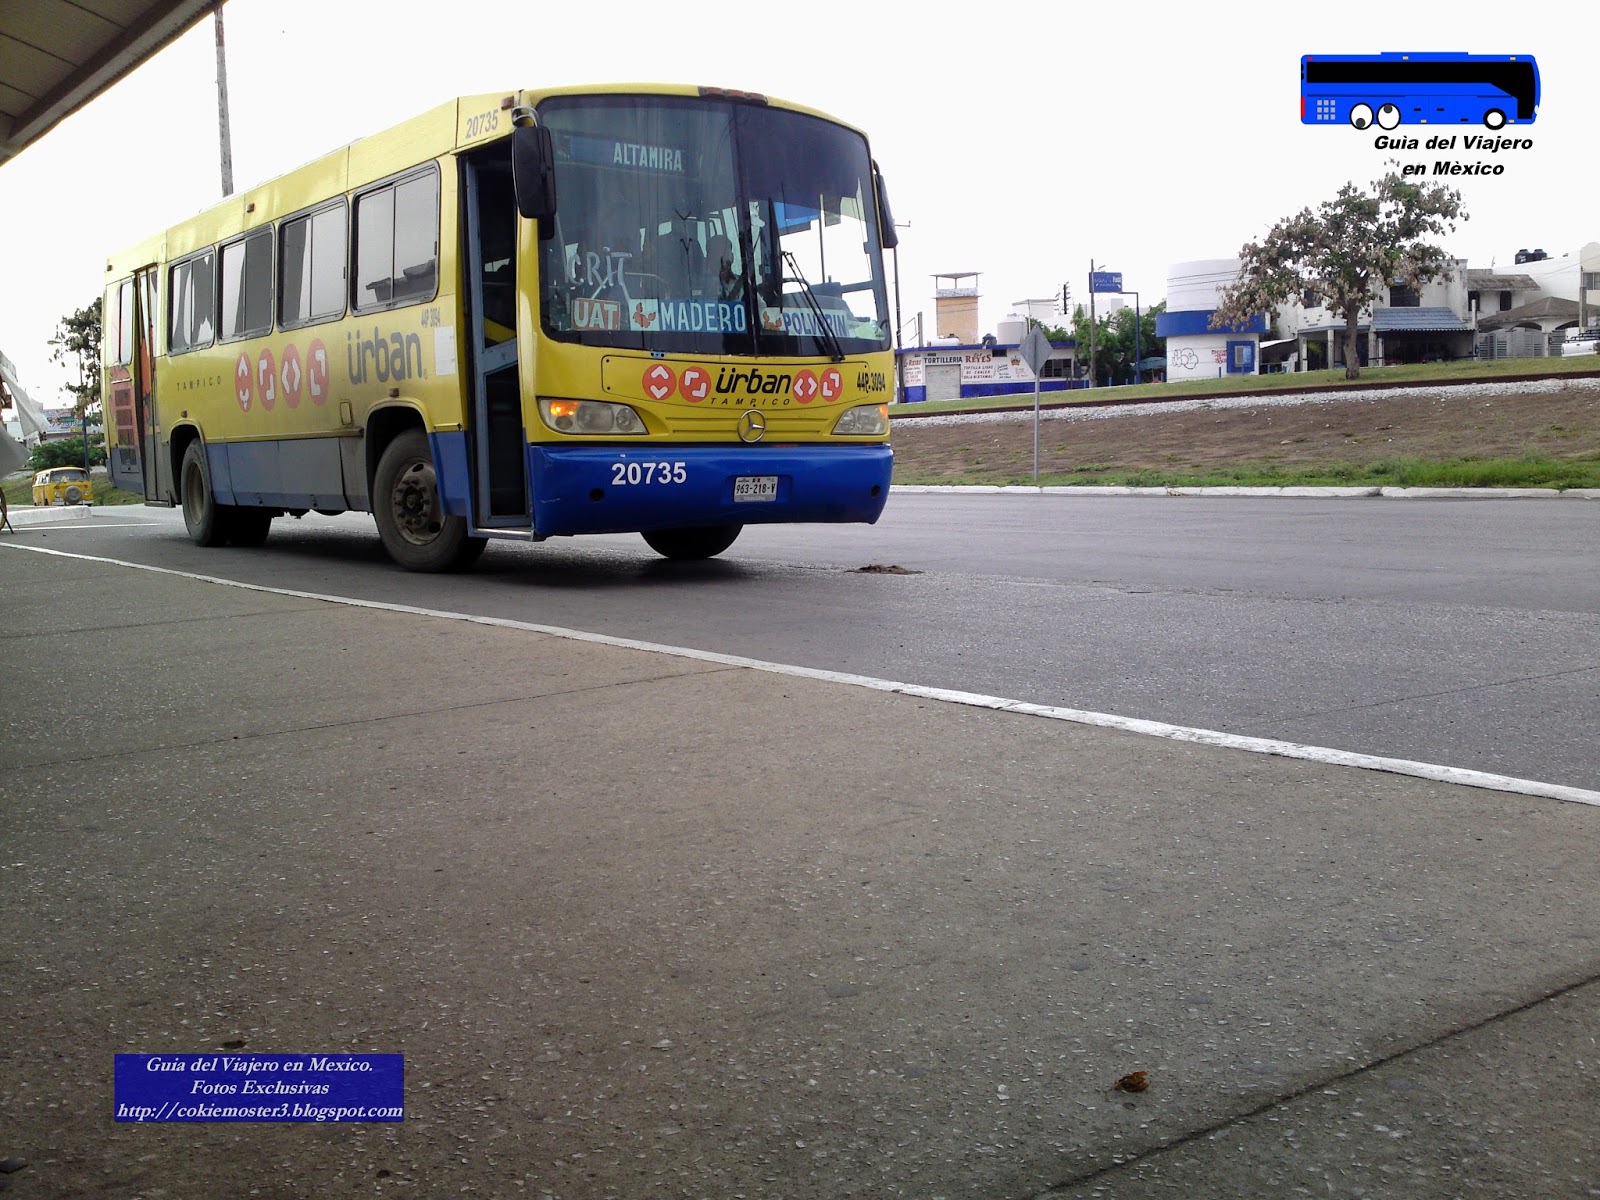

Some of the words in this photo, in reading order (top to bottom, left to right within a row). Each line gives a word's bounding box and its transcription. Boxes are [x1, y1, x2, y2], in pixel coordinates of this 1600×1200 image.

[465, 109, 499, 139] 20735
[613, 142, 683, 172] ALTAMIRA
[573, 300, 619, 329] UAT
[660, 302, 746, 332] MADERO
[346, 326, 423, 385] ürban
[923, 356, 963, 364] TORTILLERIA
[965, 354, 992, 363] REYES
[177, 376, 222, 392] TAMPICO
[715, 367, 791, 394] ürban
[711, 397, 790, 405] TAMPICO
[611, 461, 687, 486] 20735
